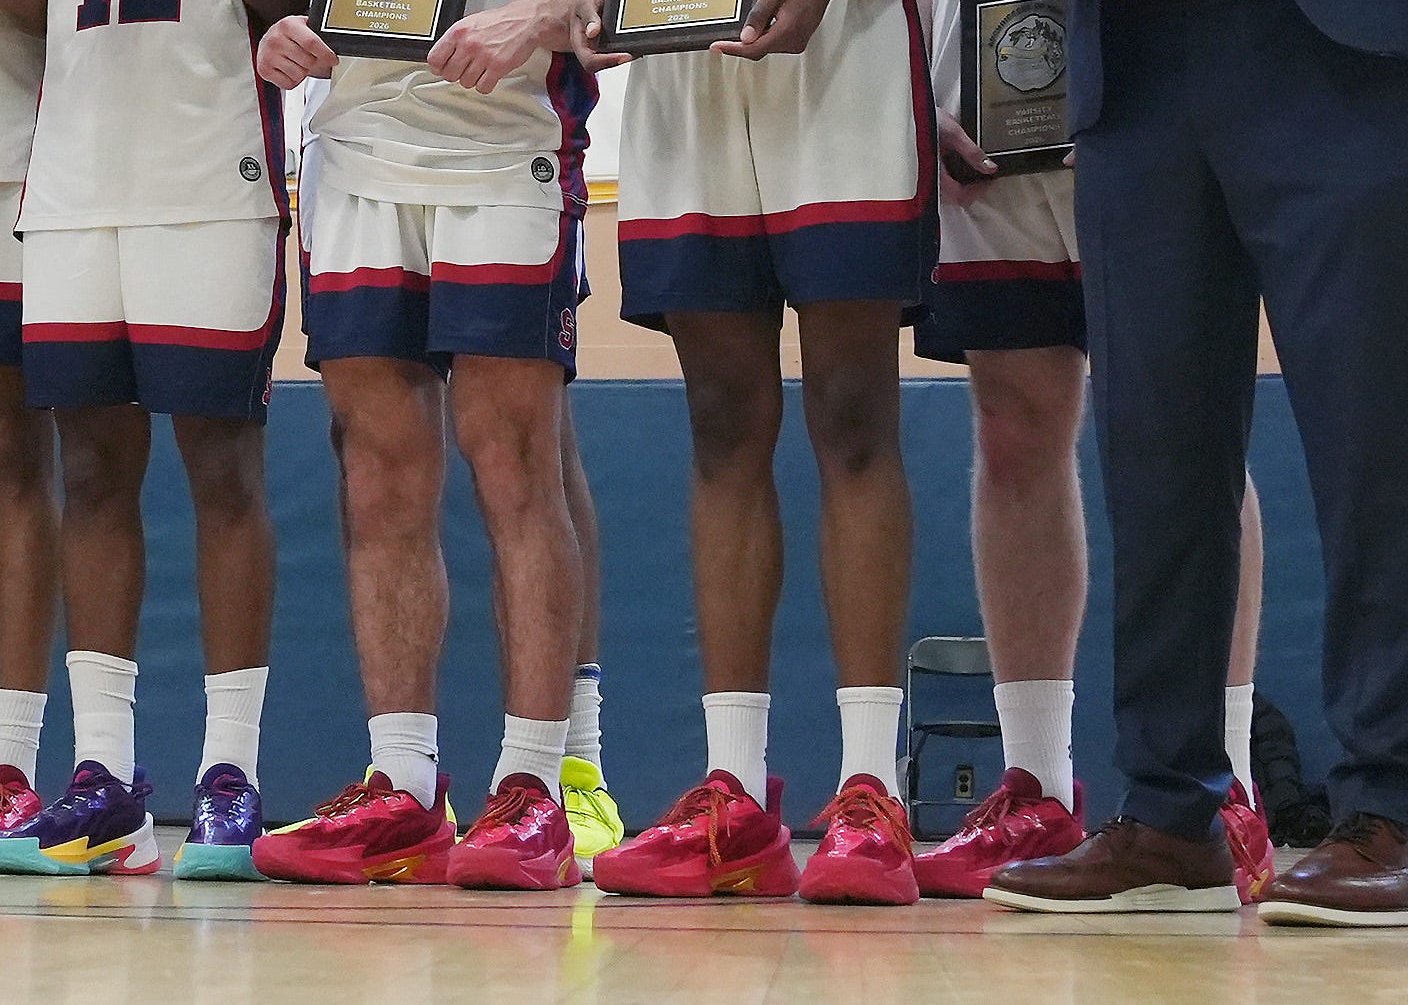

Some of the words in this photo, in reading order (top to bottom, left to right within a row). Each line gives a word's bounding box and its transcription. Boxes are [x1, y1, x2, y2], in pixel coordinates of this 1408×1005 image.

[356, 0, 412, 10] BASKETBALL
[651, 3, 708, 13] CHAMPIONS
[356, 10, 408, 20] CHAMPIONS
[559, 308, 575, 350] S
